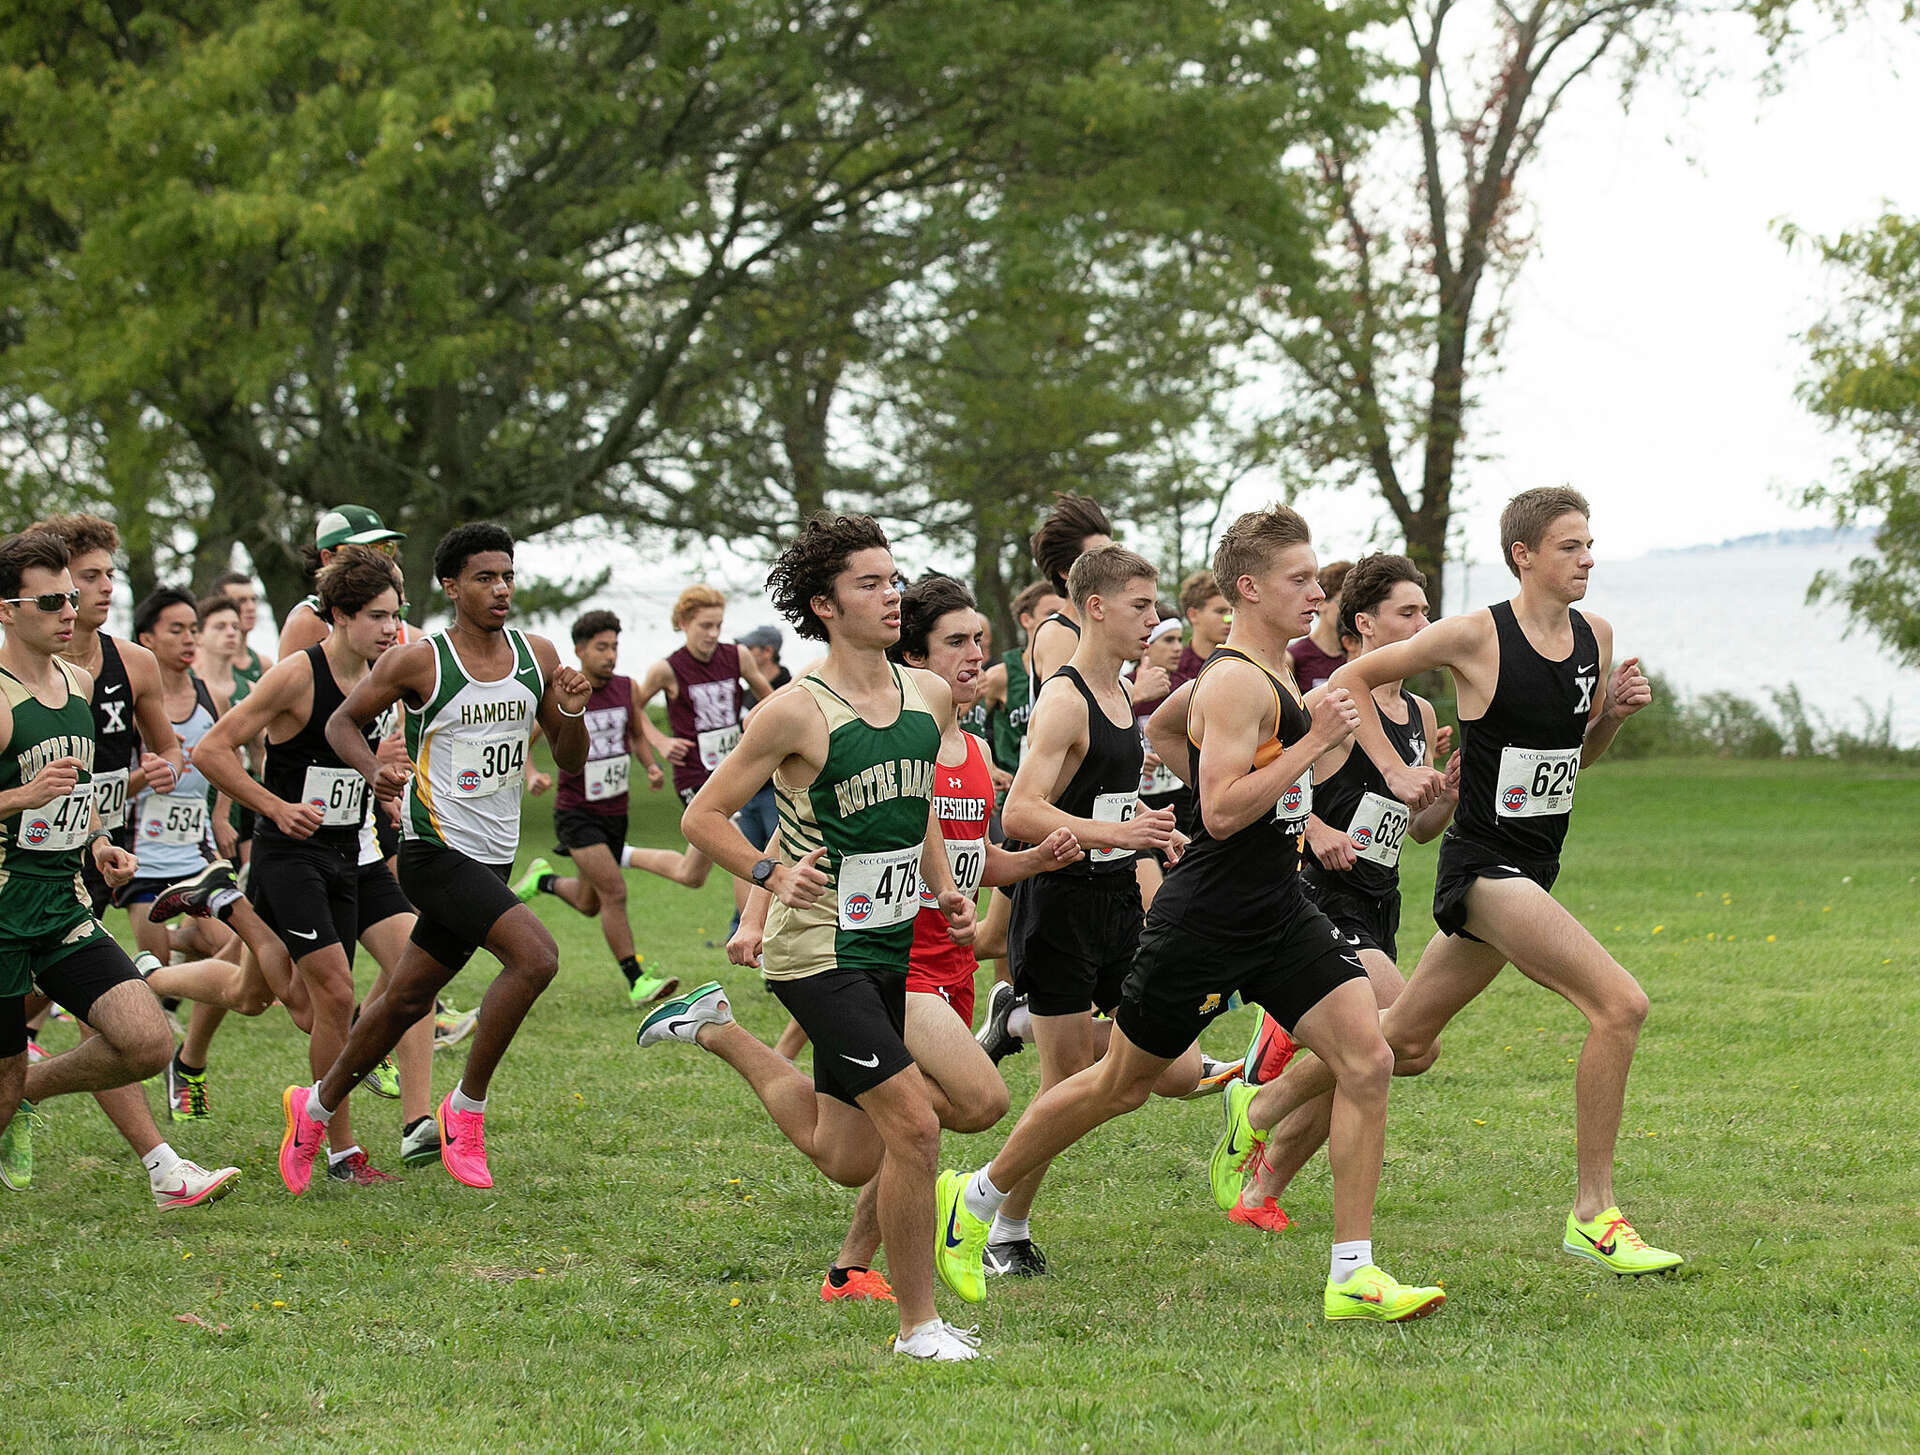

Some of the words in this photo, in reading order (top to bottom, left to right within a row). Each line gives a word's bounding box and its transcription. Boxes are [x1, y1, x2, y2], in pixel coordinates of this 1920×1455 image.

[1573, 675, 1597, 715] X
[100, 700, 127, 734] X
[460, 700, 527, 725] HAMDEN
[482, 739, 524, 779] 304
[458, 775, 481, 786] SCC
[833, 760, 898, 819] NOTRE
[1531, 757, 1578, 797] 629
[93, 779, 125, 815] 20
[932, 796, 986, 821] HESHIRE
[1503, 792, 1528, 804] SCC
[53, 793, 91, 832] 475
[167, 806, 202, 832] 534
[27, 826, 49, 838] SCC
[1352, 831, 1372, 846] SCC
[1375, 811, 1408, 850] 632
[858, 857, 876, 866] SCC
[876, 857, 919, 905] 478
[845, 902, 873, 914] SCC
